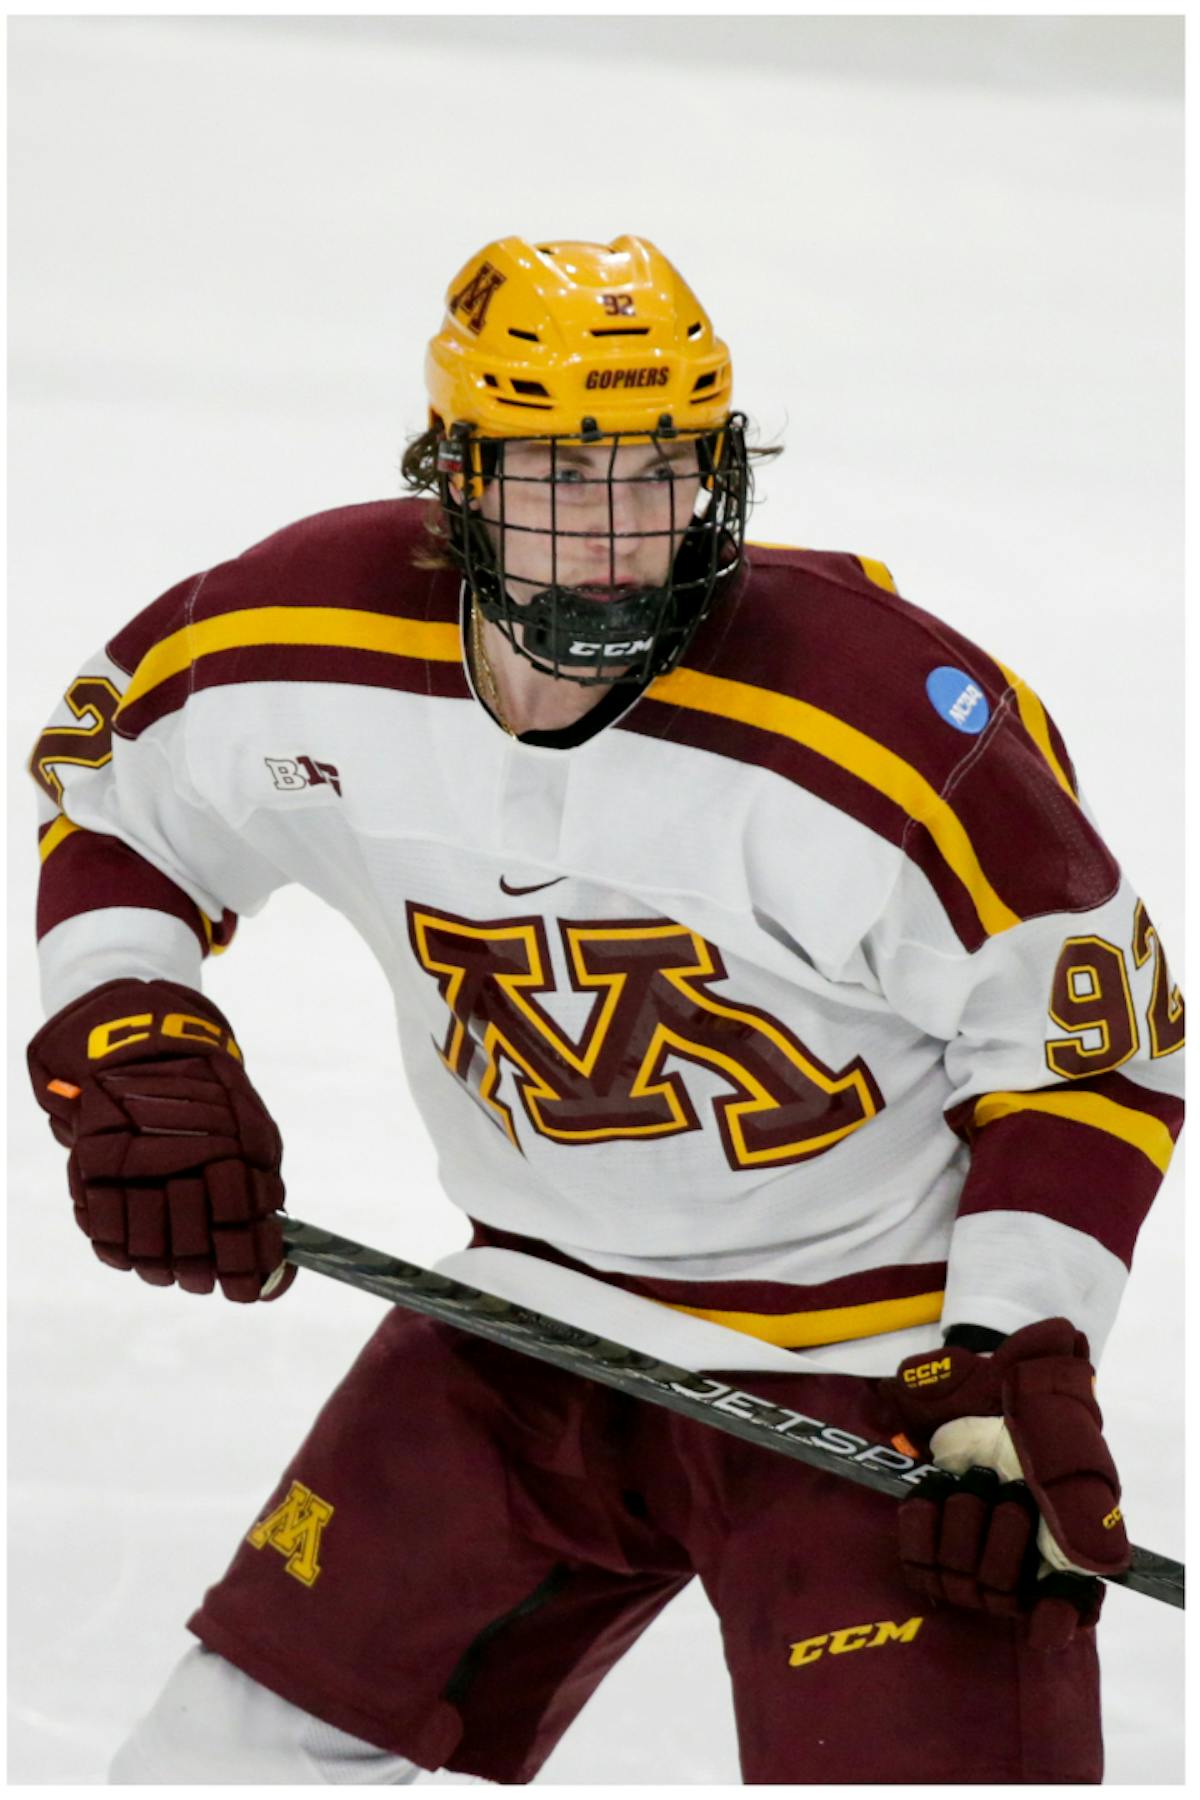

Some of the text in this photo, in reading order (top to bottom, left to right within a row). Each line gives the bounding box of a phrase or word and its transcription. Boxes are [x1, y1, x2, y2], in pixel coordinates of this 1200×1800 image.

[451, 262, 507, 335] M
[585, 365, 670, 391] GOPHERS
[568, 636, 653, 658] CCM
[1043, 898, 1185, 1081] 92
[405, 899, 887, 1172] M
[903, 1356, 951, 1383] CCM
[246, 1479, 335, 1588] M
[788, 1617, 924, 1667] CCM
